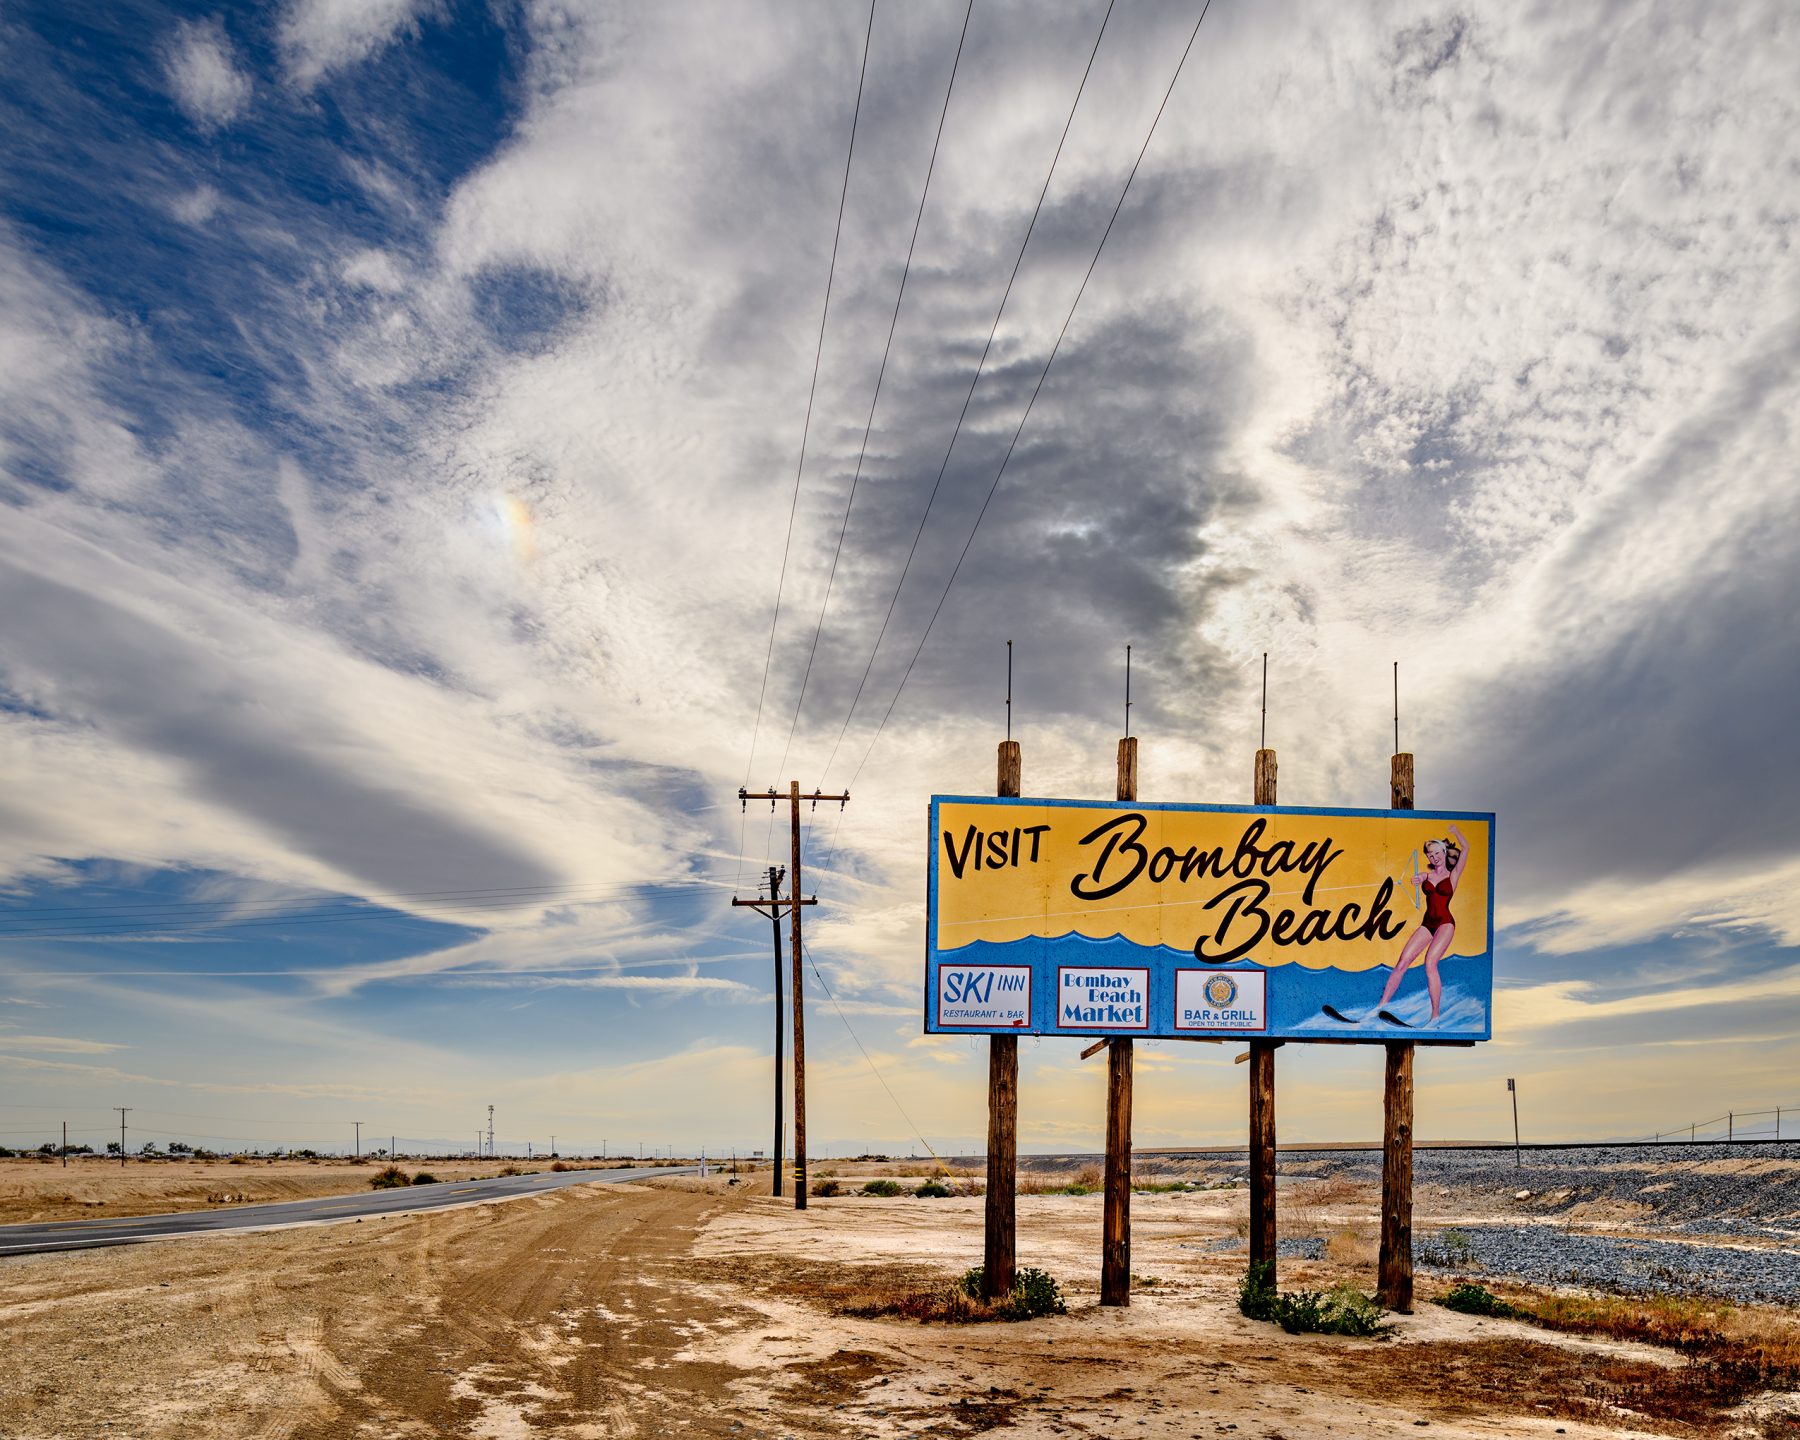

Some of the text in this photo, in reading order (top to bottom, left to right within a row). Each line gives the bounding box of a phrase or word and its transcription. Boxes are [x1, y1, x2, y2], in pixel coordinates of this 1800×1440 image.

[943, 813, 1344, 906] VISIT Bombay
[1194, 877, 1407, 964] Beach
[944, 972, 1025, 1004] SKI INN
[1064, 974, 1132, 988] Bombay
[1088, 988, 1140, 1003] Beach
[944, 1010, 996, 1018] RESTAURANT
[1062, 1004, 1144, 1022] Market
[1184, 1010, 1210, 1020] BAR
[1222, 1010, 1256, 1020] GRILL
